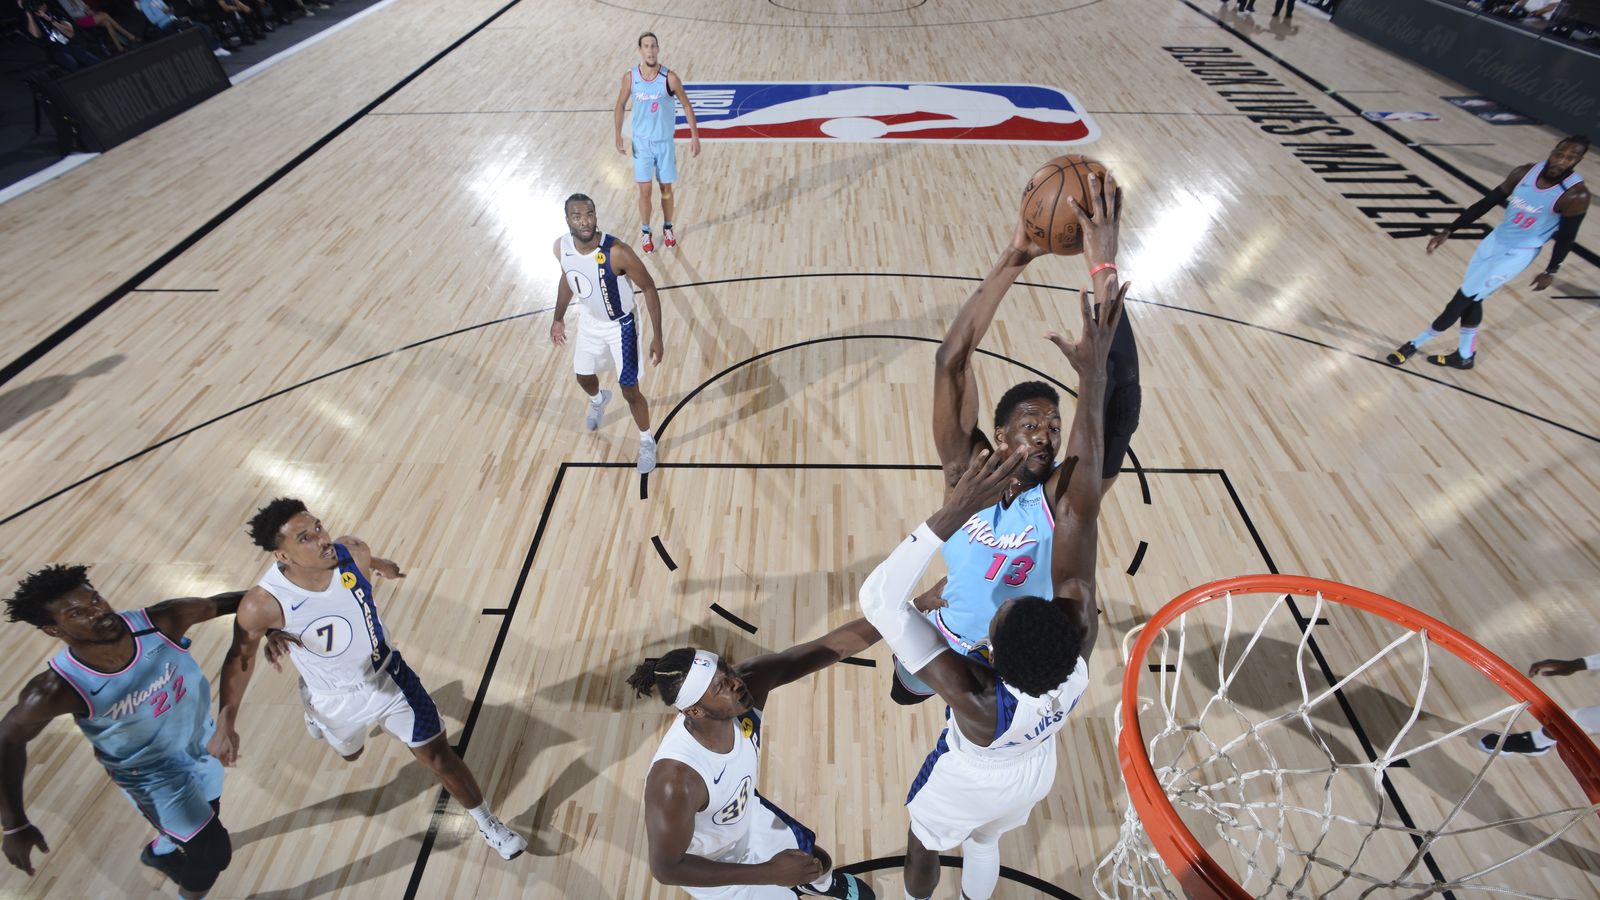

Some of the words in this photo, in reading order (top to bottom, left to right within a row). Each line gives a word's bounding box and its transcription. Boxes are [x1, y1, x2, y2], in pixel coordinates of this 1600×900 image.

[93, 71, 160, 131] WHOLE
[141, 57, 187, 109] NEW
[173, 45, 220, 94] GAME
[1162, 46, 1285, 87] BLACK
[1465, 48, 1544, 99] Florida
[1536, 79, 1595, 117] Blue
[650, 101, 659, 113] 9
[1216, 90, 1355, 137] LIVES
[1280, 142, 1494, 240] MATTER
[574, 275, 582, 294] 1
[599, 268, 616, 317] PACERS
[961, 513, 1038, 550] Miami
[984, 553, 1035, 588] 13
[316, 623, 334, 652] 7
[354, 588, 381, 663] PACERS
[102, 661, 178, 721] Miami
[150, 675, 187, 718] 22
[1024, 710, 1064, 741] LIVES
[721, 778, 748, 824] 33
